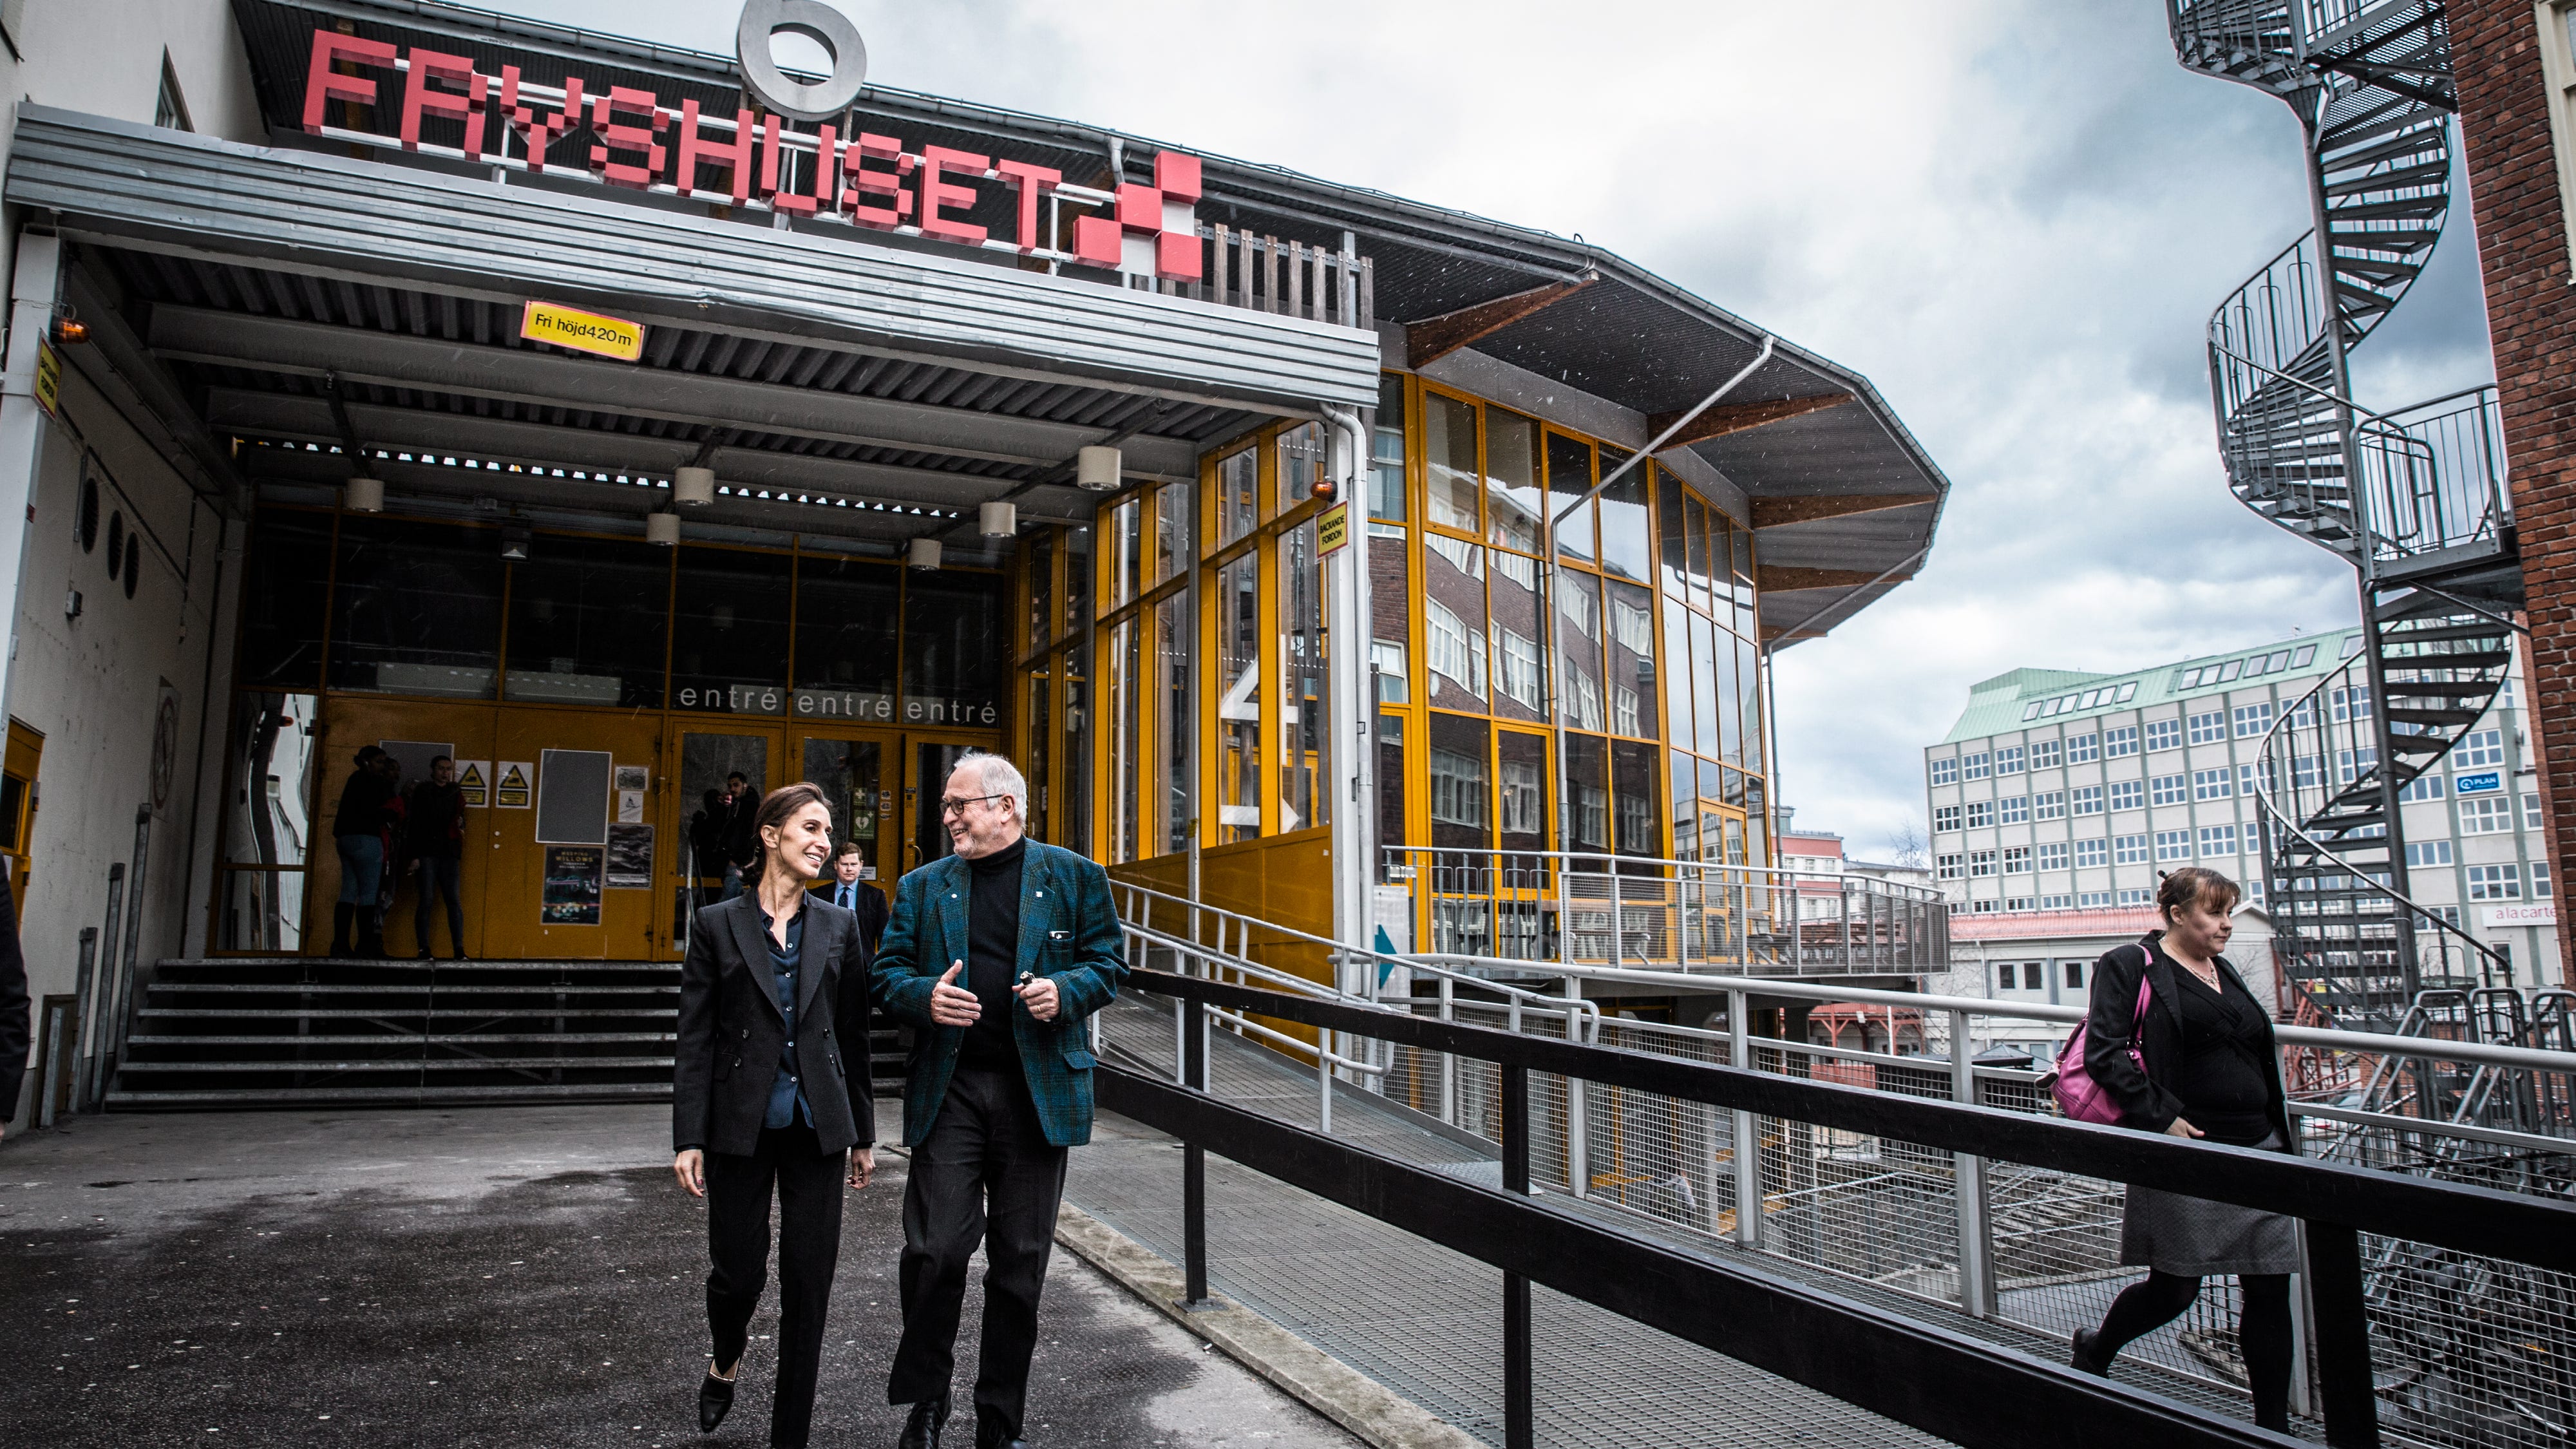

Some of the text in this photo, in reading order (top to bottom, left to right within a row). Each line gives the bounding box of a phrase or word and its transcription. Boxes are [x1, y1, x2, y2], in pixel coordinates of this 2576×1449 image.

[303, 28, 1062, 255] FRYSHUSET
[535, 313, 553, 328] Fri
[618, 334, 632, 346] m
[1319, 515, 1345, 535] BACKANDE
[1321, 529, 1342, 545] FORDON
[679, 686, 996, 724] entré entré entré
[2474, 777, 2497, 785] PLAN
